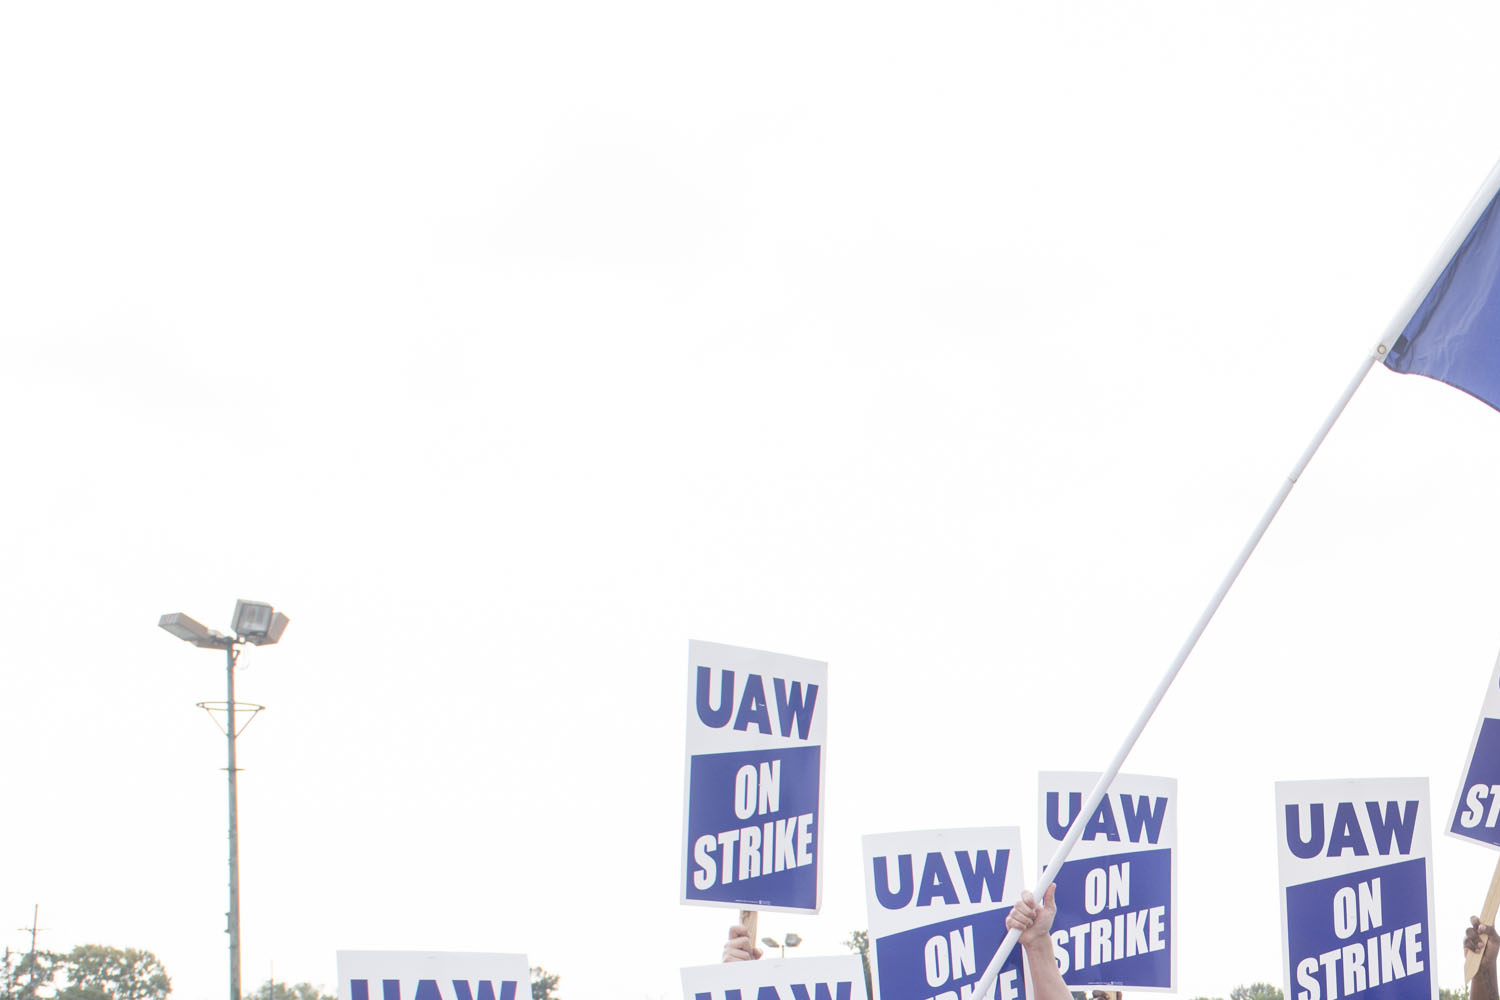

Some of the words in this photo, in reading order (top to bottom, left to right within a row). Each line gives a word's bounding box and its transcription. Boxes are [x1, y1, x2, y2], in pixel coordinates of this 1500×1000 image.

[695, 665, 819, 741] UAW
[734, 760, 781, 820] ON
[1046, 791, 1169, 845] UAW
[693, 812, 813, 890] STRIKE
[1285, 800, 1419, 859] UAW
[873, 849, 1011, 910] UAW
[1084, 861, 1131, 915] ON
[1333, 877, 1382, 940] ON
[924, 925, 976, 988] ON
[1050, 905, 1166, 976] STRIKE
